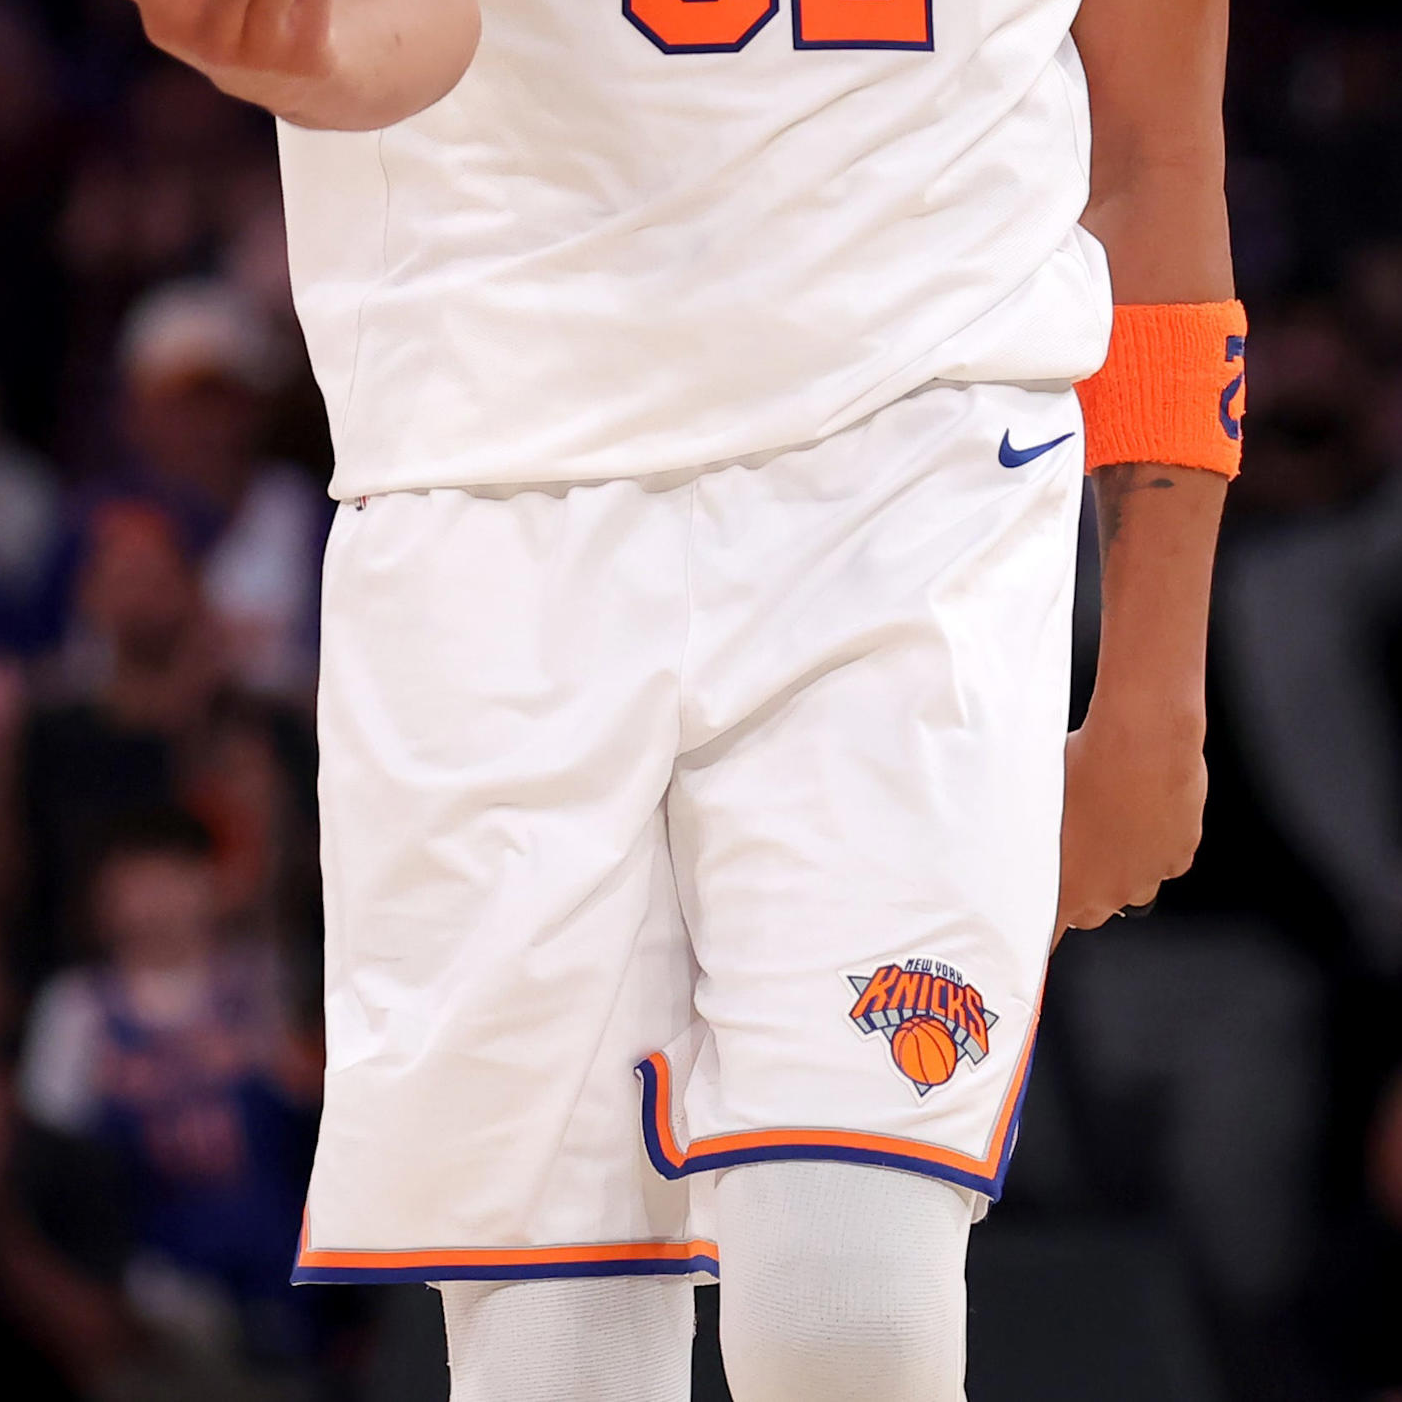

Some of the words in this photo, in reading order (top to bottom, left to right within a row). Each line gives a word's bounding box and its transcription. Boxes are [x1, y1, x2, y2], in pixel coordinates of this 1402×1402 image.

[904, 958, 933, 972] NEW
[935, 961, 964, 986] YORK
[849, 964, 989, 1054] KNICKS
